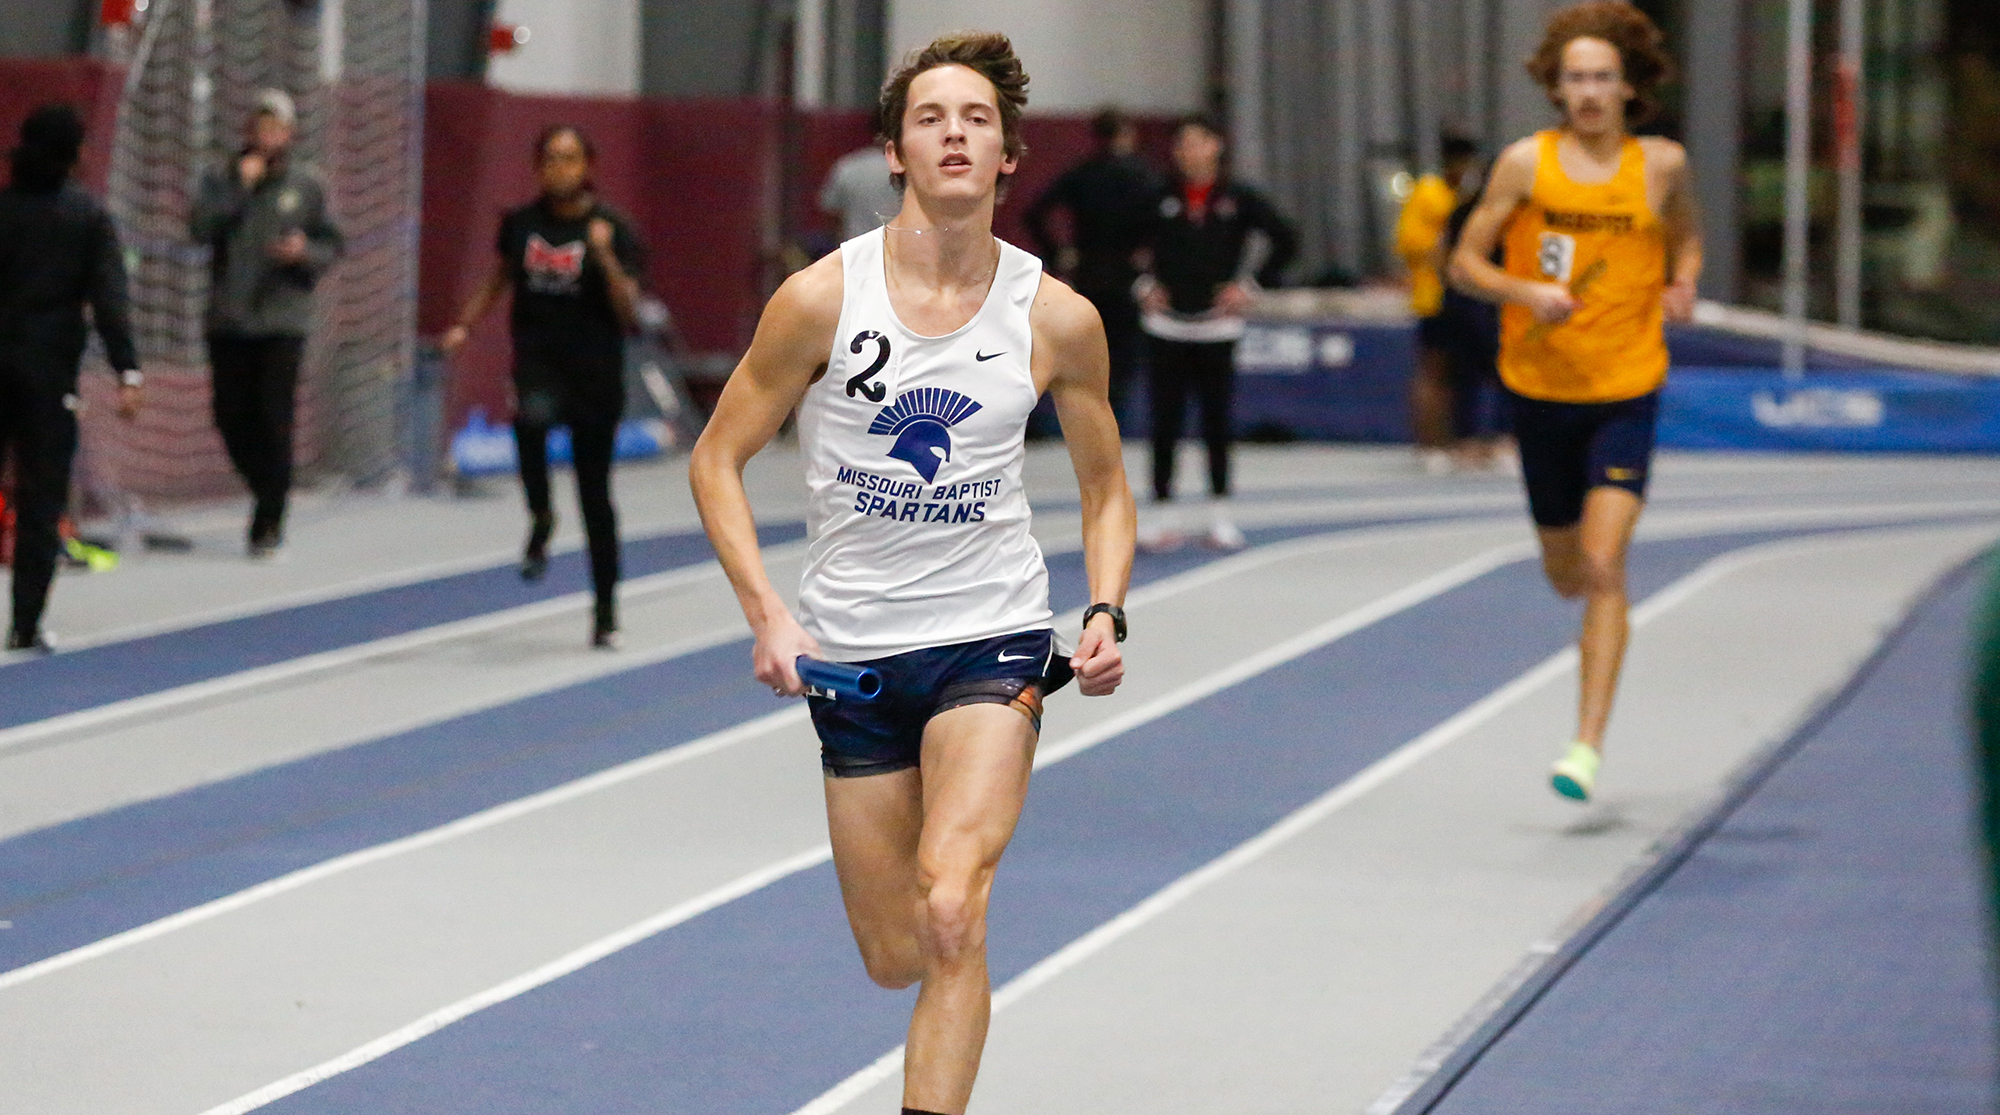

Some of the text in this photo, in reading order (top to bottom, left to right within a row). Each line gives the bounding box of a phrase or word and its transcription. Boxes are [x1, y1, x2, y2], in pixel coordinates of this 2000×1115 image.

[846, 330, 891, 403] 2
[837, 466, 1001, 500] MISSOURI BAPTIST
[854, 491, 986, 523] SPARTANS
